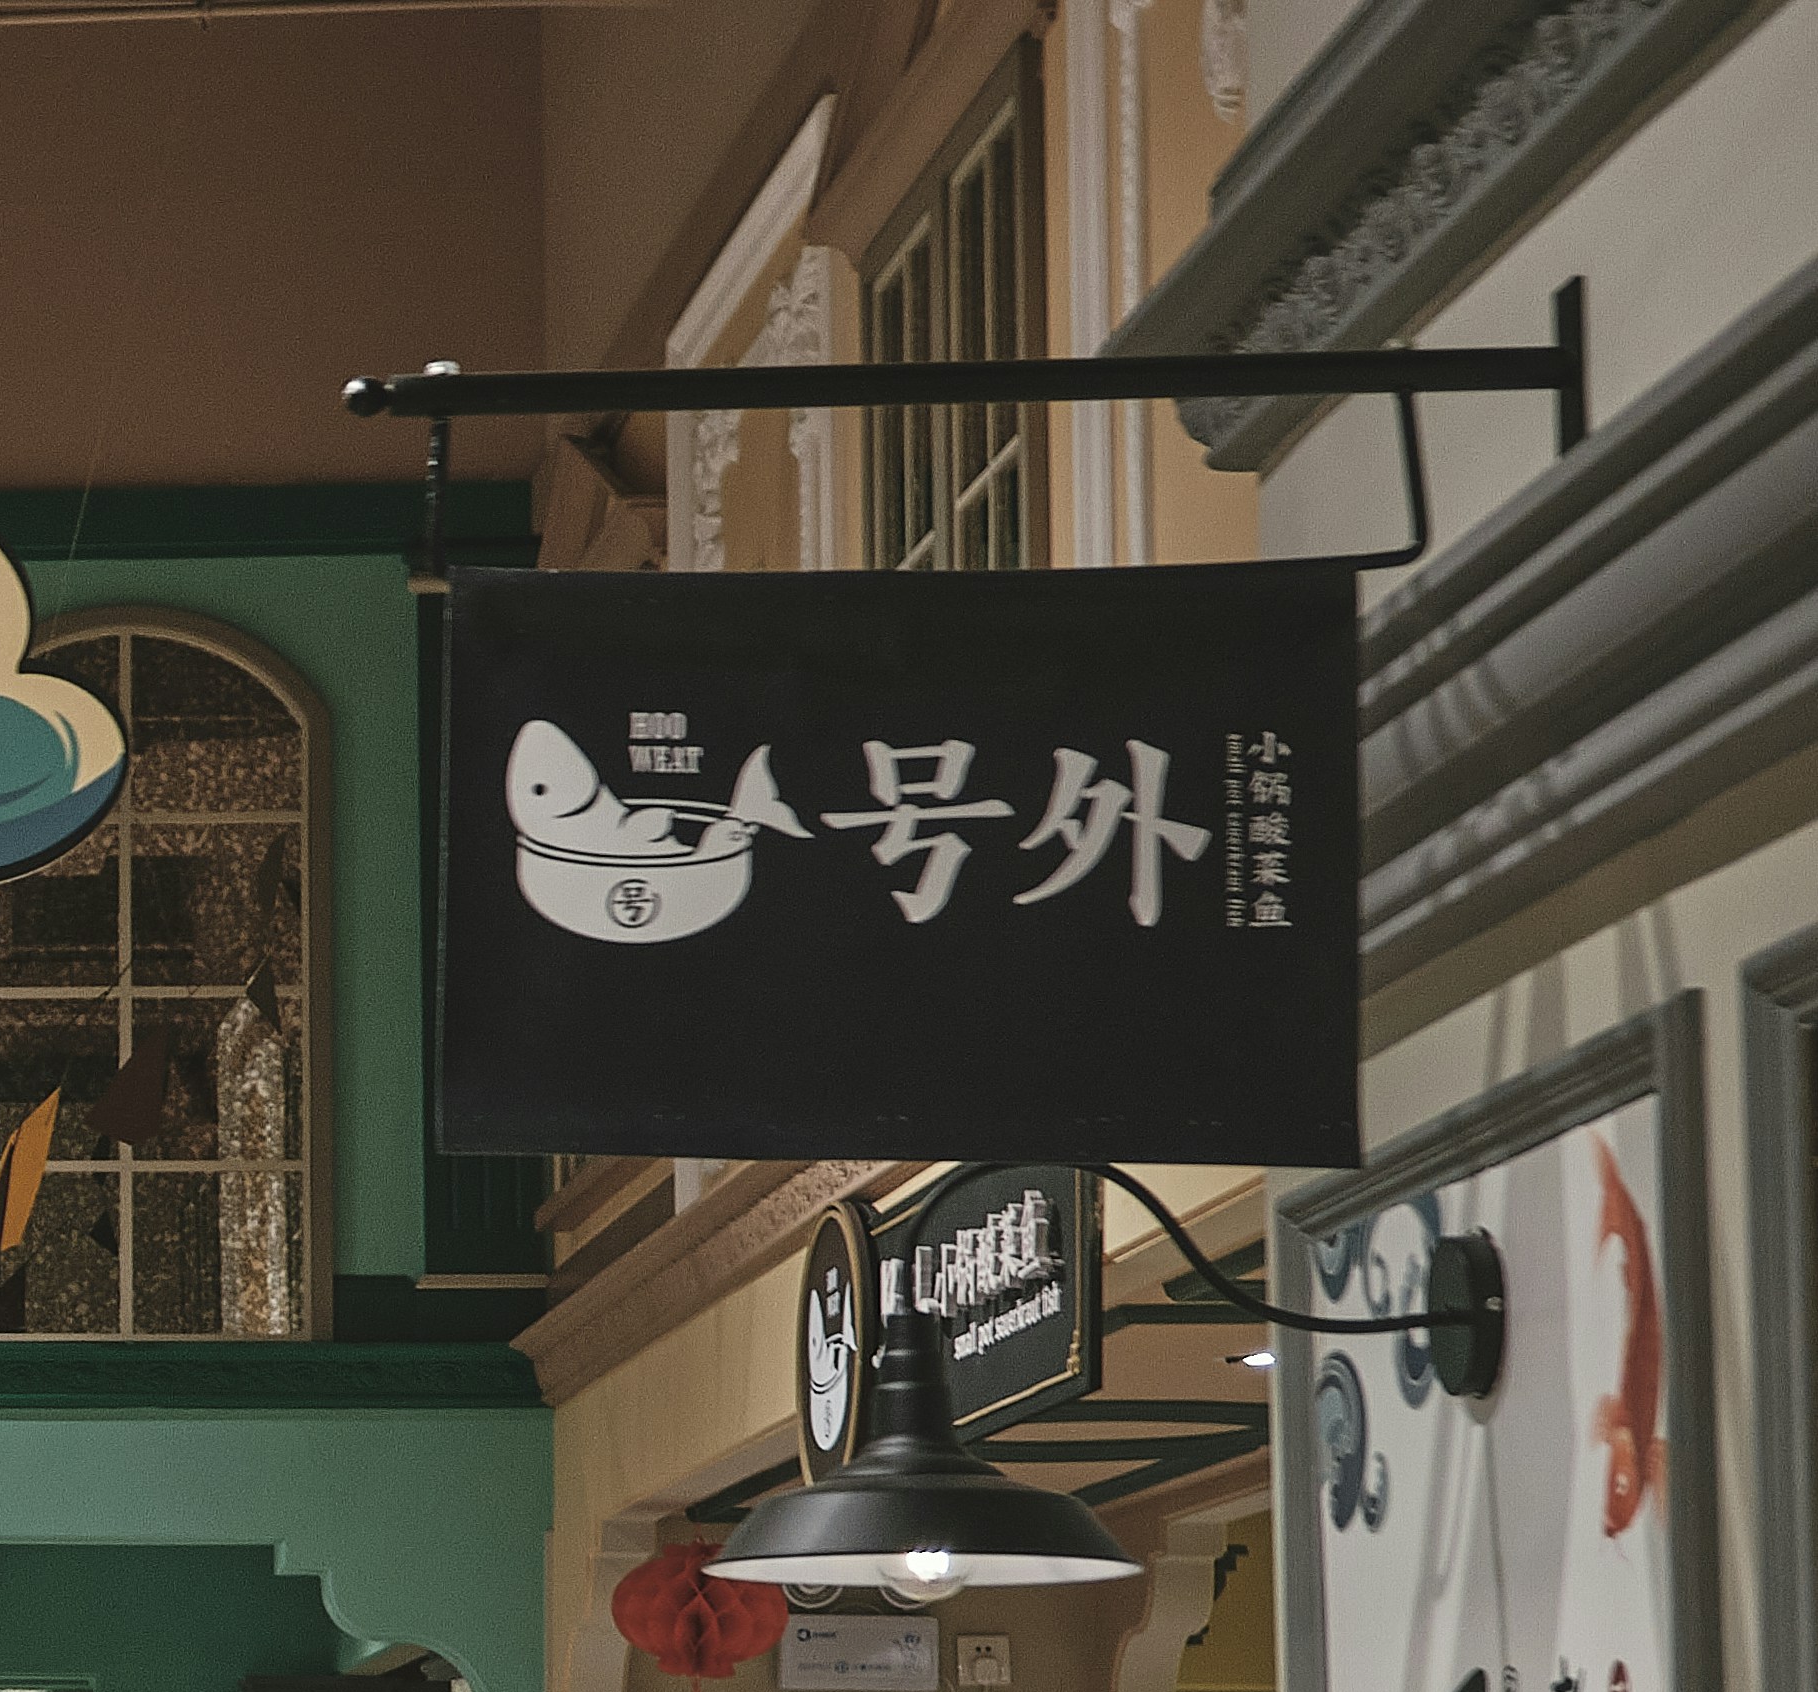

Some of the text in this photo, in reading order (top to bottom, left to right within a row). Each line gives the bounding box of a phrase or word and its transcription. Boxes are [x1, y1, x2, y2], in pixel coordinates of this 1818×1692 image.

[820, 738, 1214, 928] 号外
[1246, 731, 1293, 927] 小锅酸菜鱼
